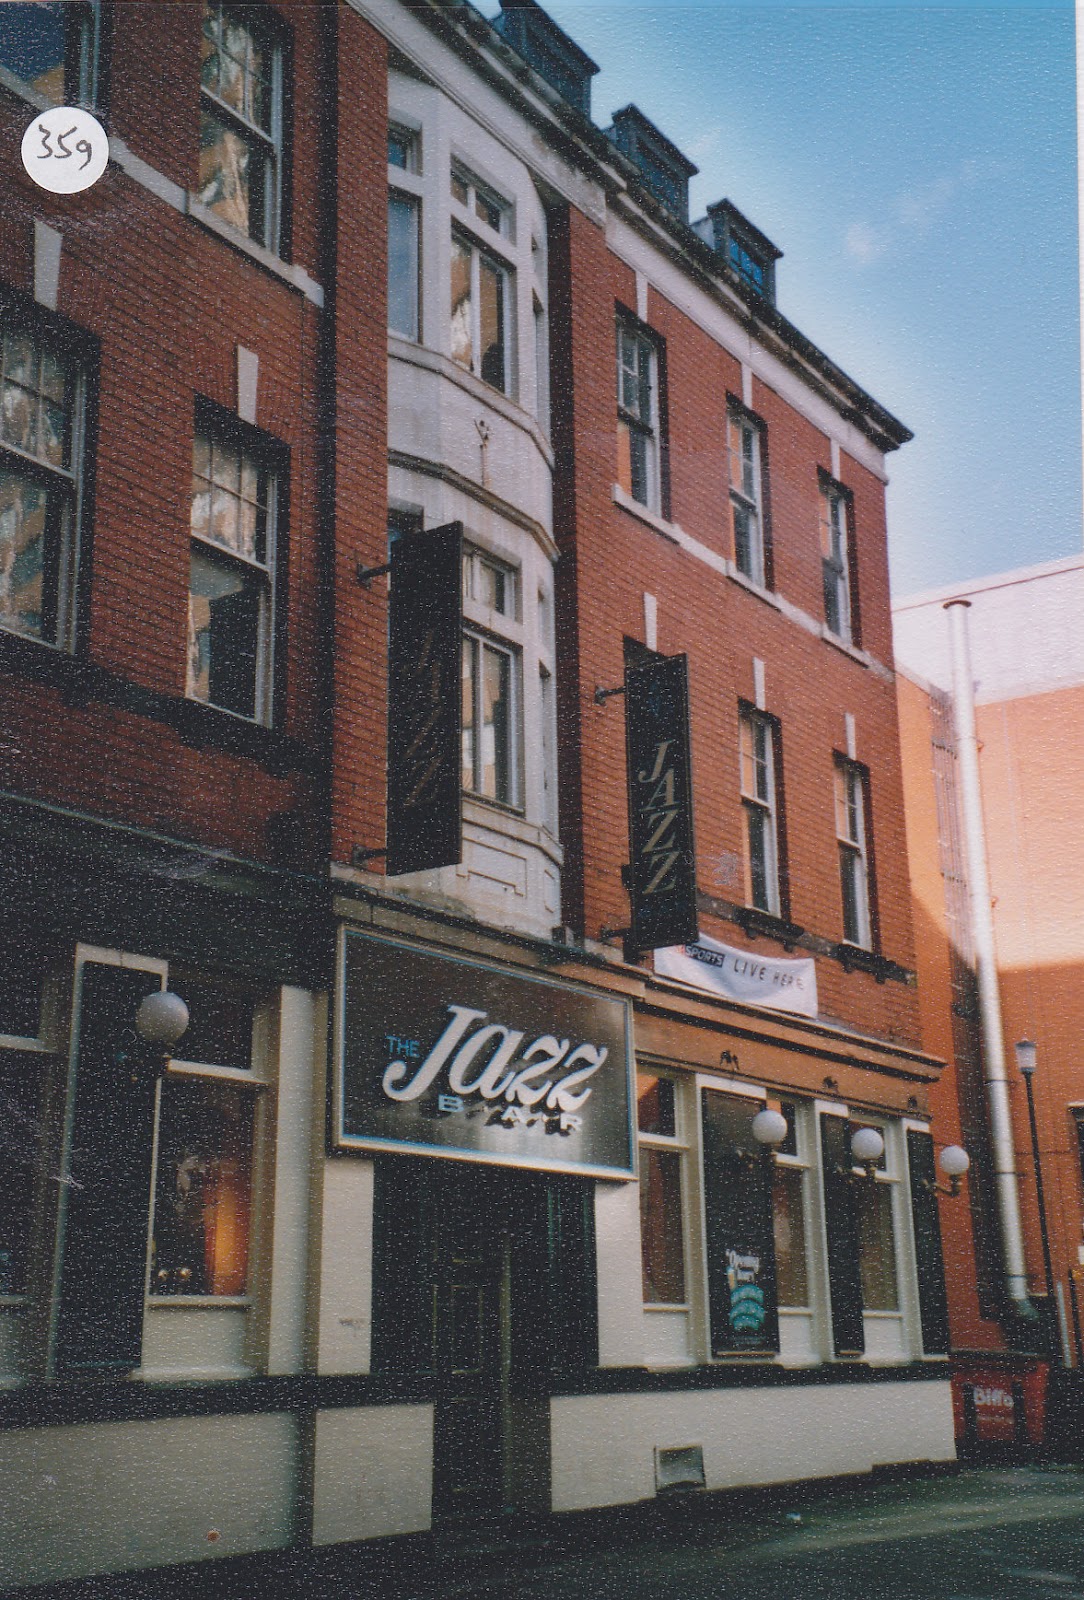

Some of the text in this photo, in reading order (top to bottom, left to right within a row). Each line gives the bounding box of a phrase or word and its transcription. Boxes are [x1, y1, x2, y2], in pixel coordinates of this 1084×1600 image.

[36, 124, 92, 171] 359
[637, 738, 681, 895] JAZZ
[685, 945, 804, 990] SPORTS LIVE HERE
[385, 1036, 420, 1059] THE
[438, 1094, 583, 1132] BAR
